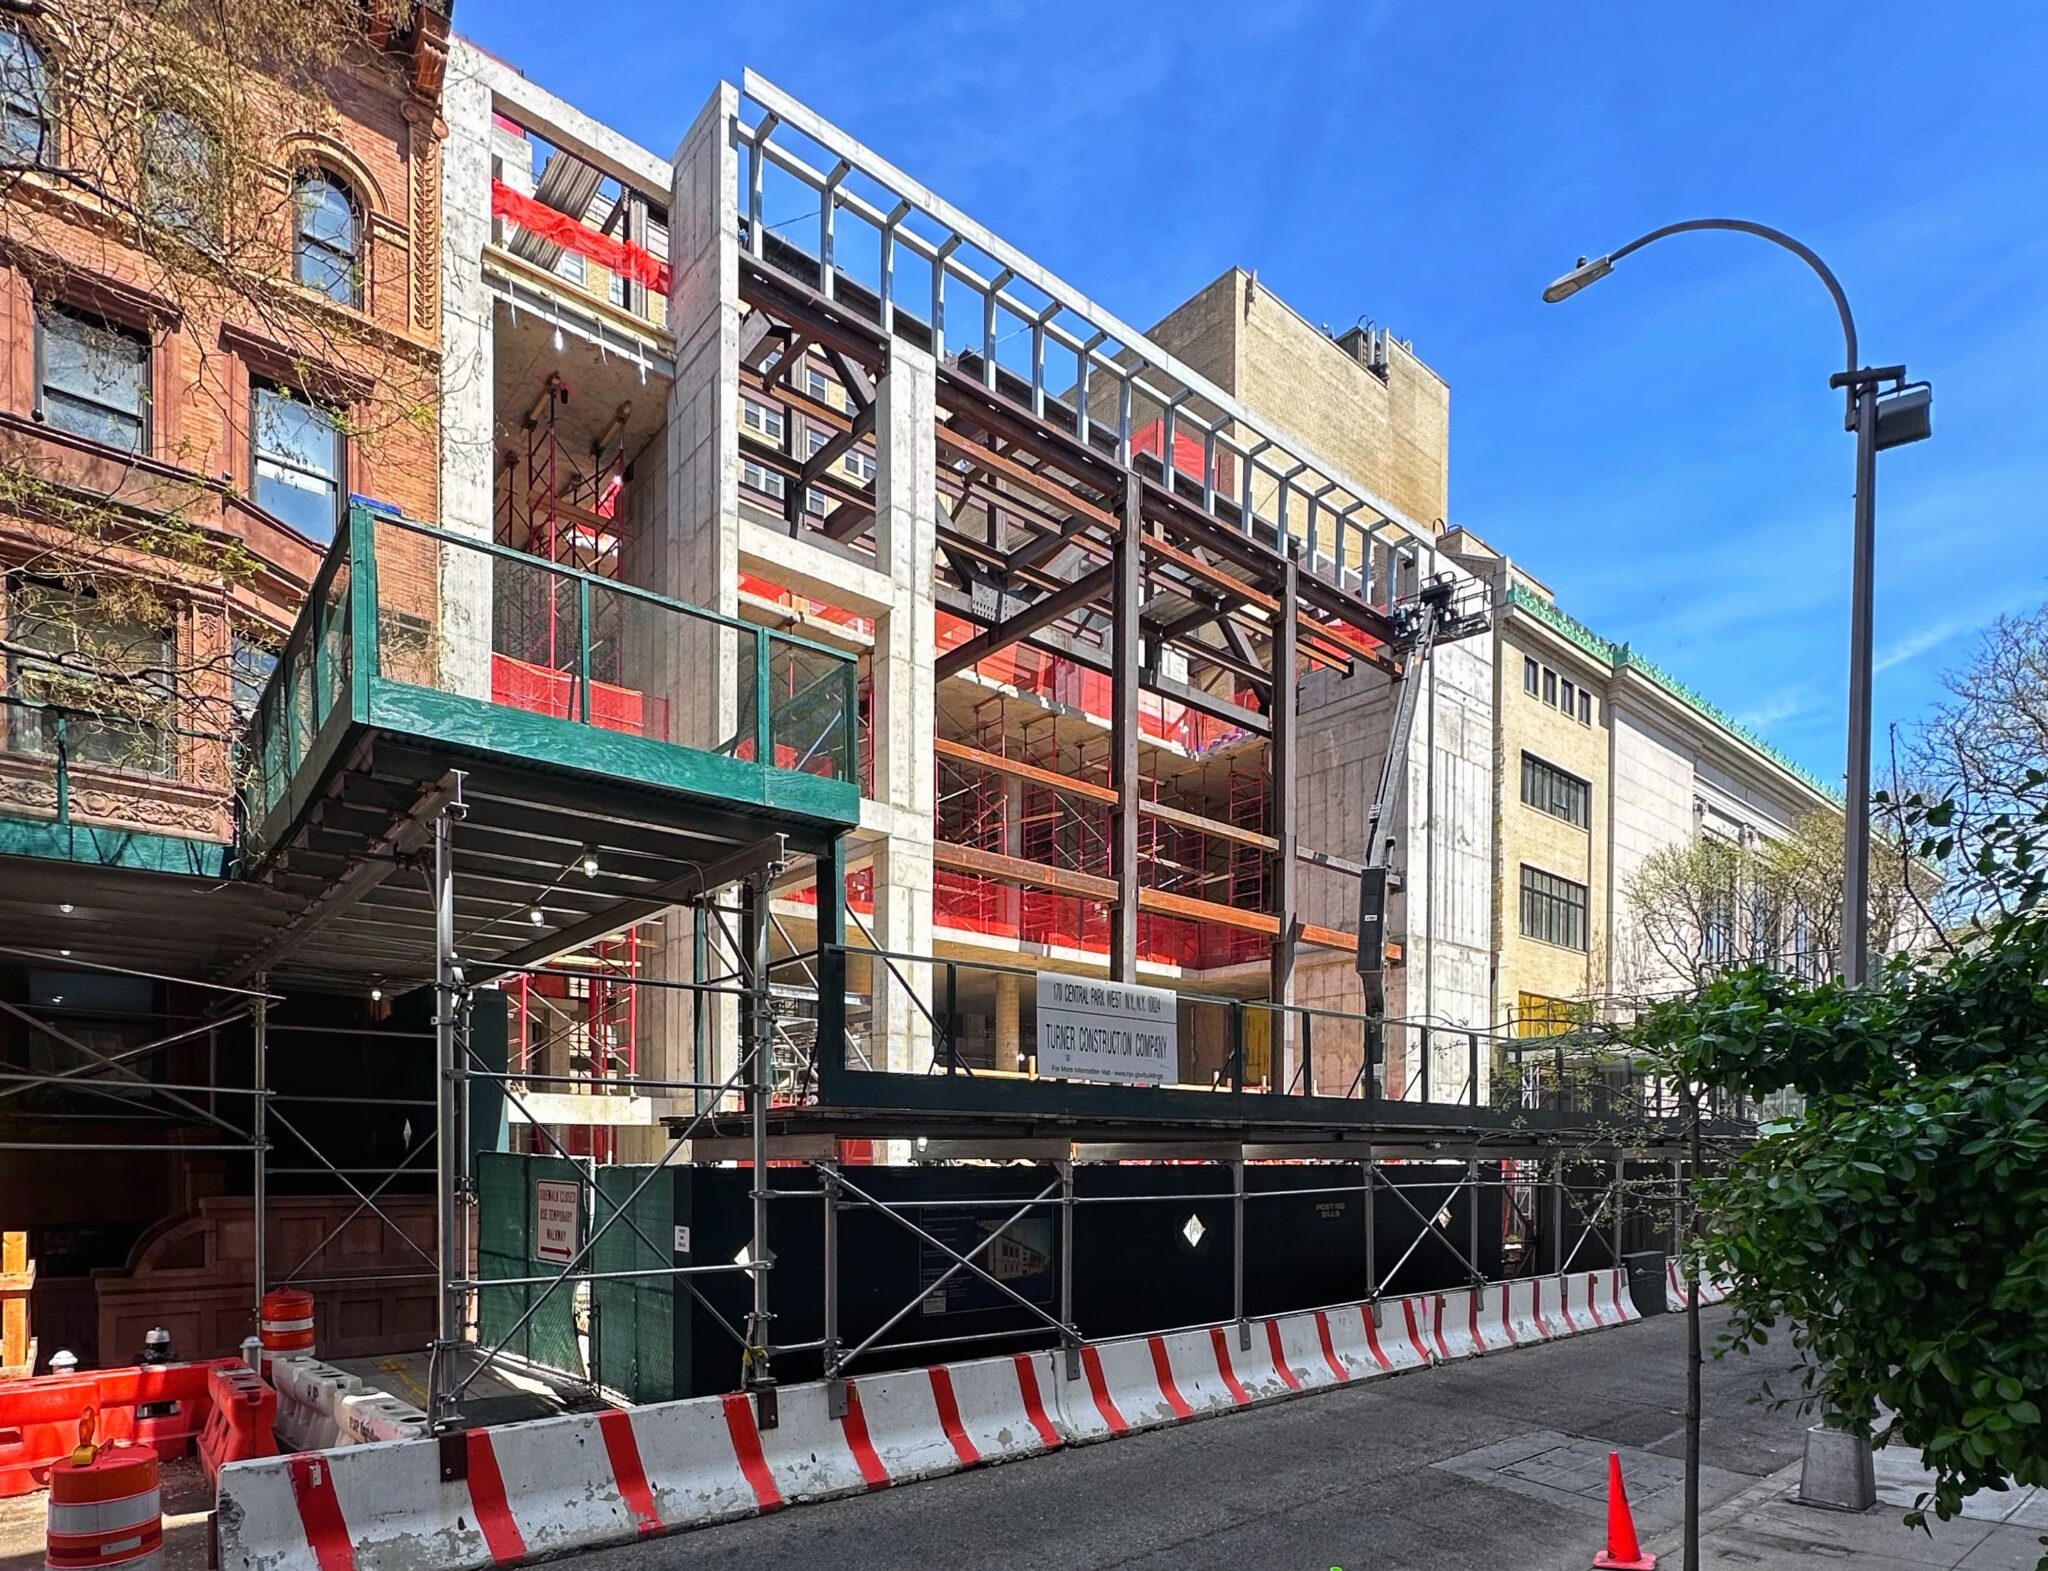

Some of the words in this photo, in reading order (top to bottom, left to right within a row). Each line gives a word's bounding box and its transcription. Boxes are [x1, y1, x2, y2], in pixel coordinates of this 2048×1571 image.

[1053, 983, 1063, 1001] 170
[1064, 984, 1089, 1005] CENTRAL
[1090, 987, 1105, 1006] PARK
[1106, 990, 1122, 1008] WEST
[1046, 1024, 1075, 1051] TURNER
[1079, 1027, 1132, 1056] CONSTRUCTION
[1135, 1033, 1167, 1059] COMPANY
[560, 1190, 576, 1204] CLOSED
[548, 1209, 573, 1223] TEMPORARY
[546, 1228, 566, 1241] WALKWAY
